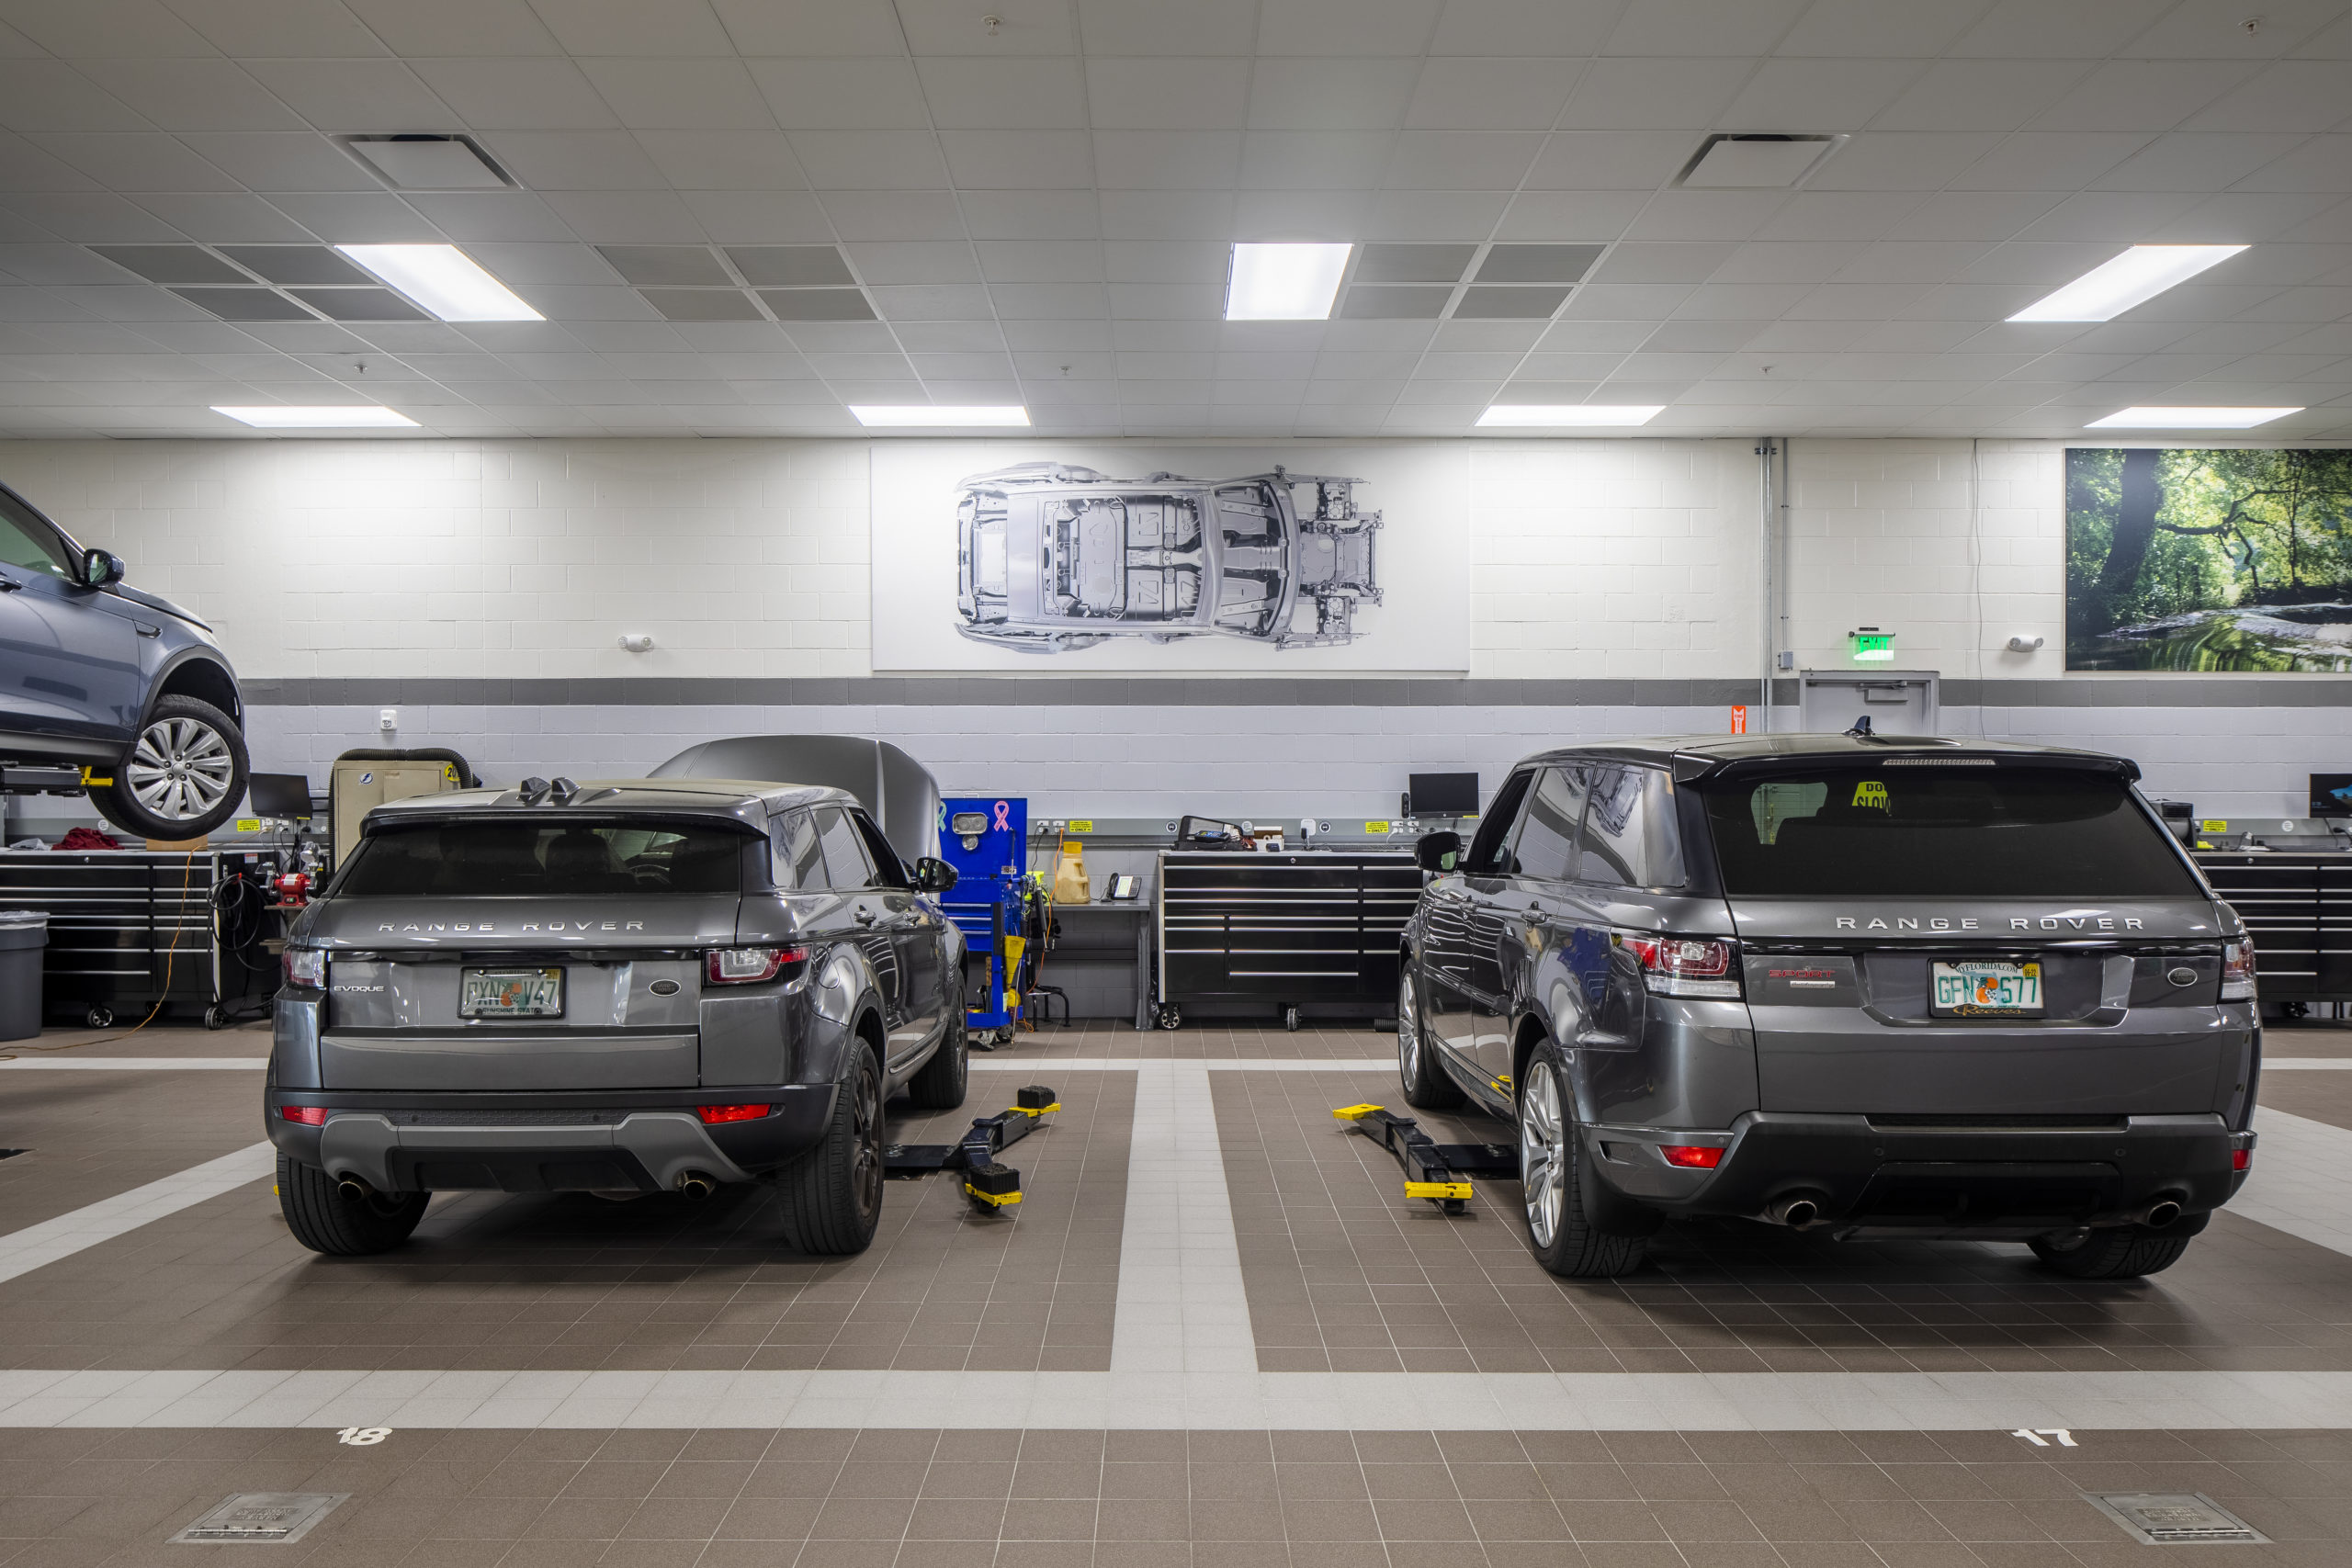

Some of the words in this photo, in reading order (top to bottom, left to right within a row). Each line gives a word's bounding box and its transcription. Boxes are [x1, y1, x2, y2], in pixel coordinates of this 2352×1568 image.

[1860, 637, 1890, 653] EXIT
[378, 922, 496, 931] RANGE
[522, 920, 644, 931] ROVER
[1836, 917, 1979, 930] RANGE
[2009, 918, 2143, 931] ROVER
[1769, 969, 1836, 978] SPORT
[1955, 962, 2018, 974] MYFLORIDA.COM
[524, 980, 557, 1005] V47
[1938, 976, 1975, 1004] GFN
[2000, 976, 2037, 1004] S77
[1952, 1004, 2027, 1016] Reeves
[336, 1427, 393, 1446] 18
[2011, 1428, 2079, 1447] 17
